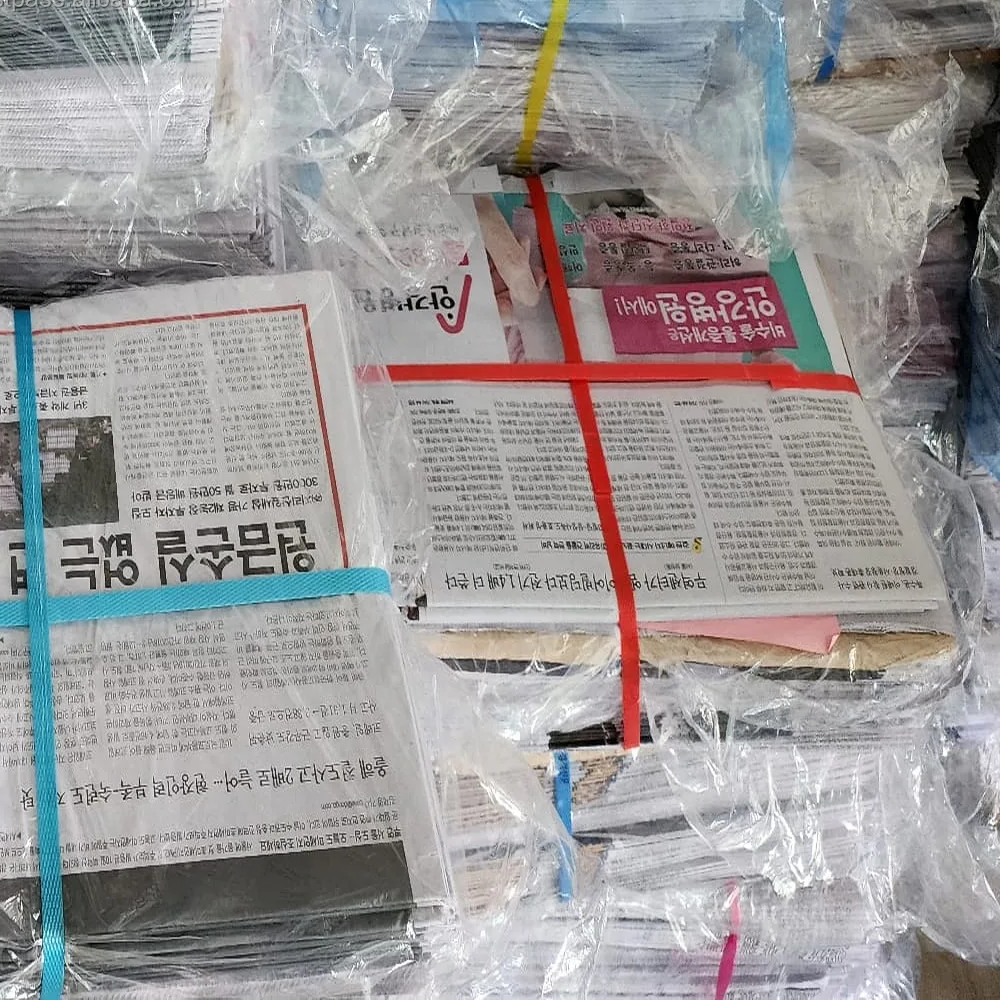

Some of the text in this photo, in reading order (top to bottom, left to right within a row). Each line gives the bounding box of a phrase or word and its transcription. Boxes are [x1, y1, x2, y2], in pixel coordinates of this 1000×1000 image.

[613, 286, 776, 325] 안강병원에서!
[667, 323, 786, 344] 비수술 통증개선은
[61, 386, 88, 396] 금융권
[51, 401, 69, 411] 계약
[189, 486, 221, 499] 50만원
[239, 481, 269, 494] 투자로
[132, 490, 151, 502] 받아
[131, 507, 151, 519] 모집
[155, 506, 185, 518] 투자자
[227, 501, 248, 513] 가평
[155, 519, 316, 585] 원금손실
[60, 533, 139, 590] 없는
[445, 573, 706, 591] 무역센터가 엠이어빌딩보다 전기 1.4배 더 쓴다
[360, 699, 376, 714] 사고
[297, 760, 355, 785] 철도사고
[359, 756, 389, 780] 올해
[256, 766, 293, 789] 2배로
[152, 772, 208, 798] 현장인력
[19, 787, 34, 810] 탓
[325, 832, 347, 844] 오늘도
[371, 829, 384, 840] 서울
[260, 837, 294, 850] 조심하세요
